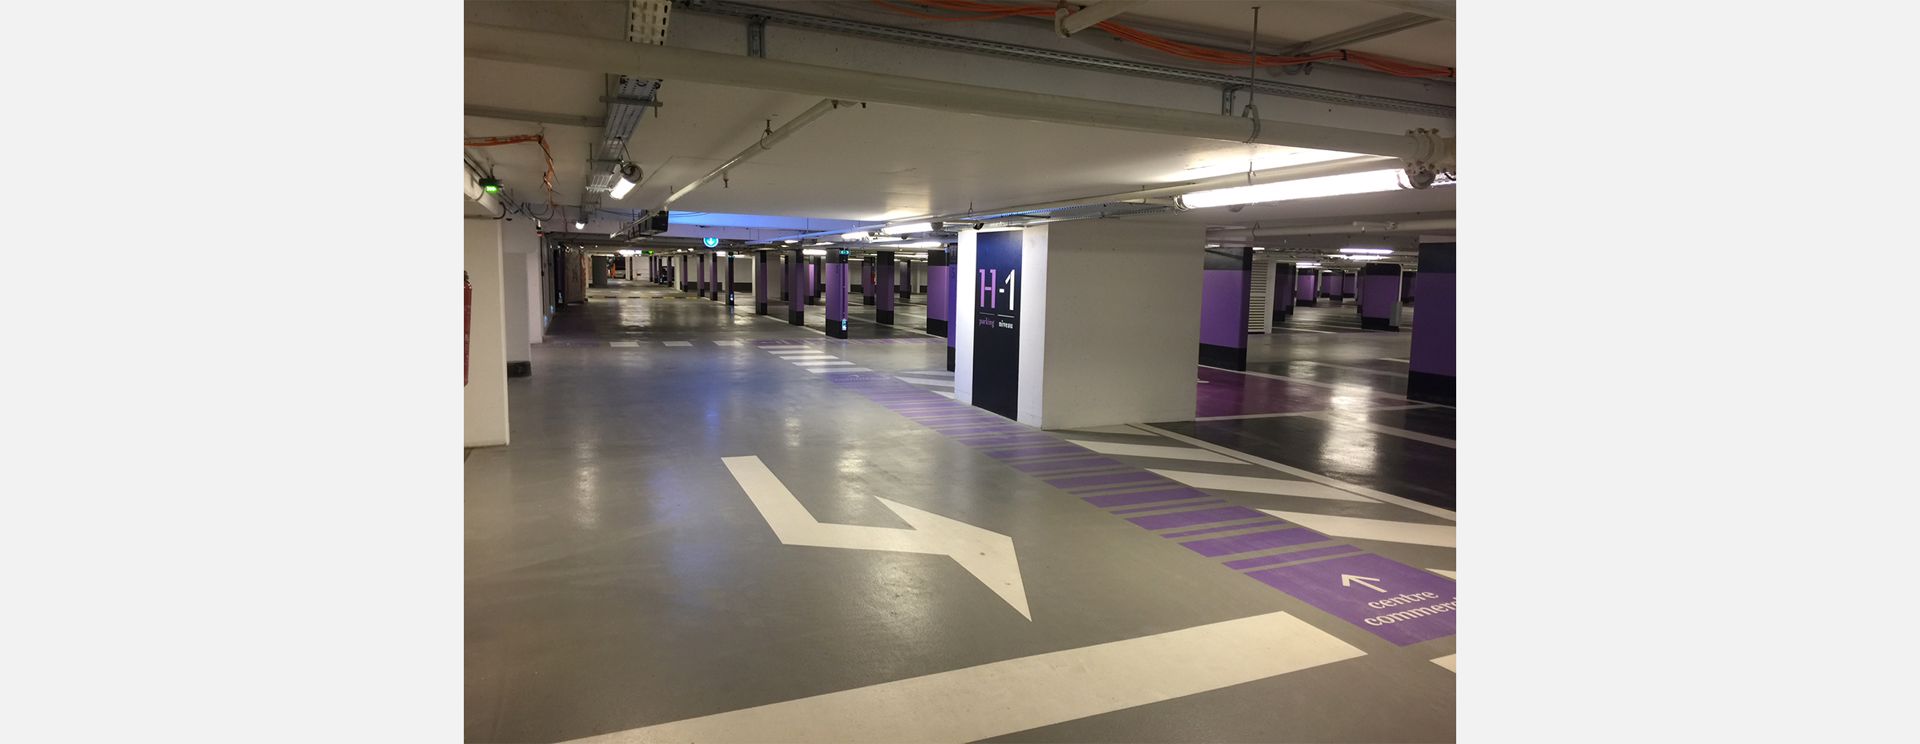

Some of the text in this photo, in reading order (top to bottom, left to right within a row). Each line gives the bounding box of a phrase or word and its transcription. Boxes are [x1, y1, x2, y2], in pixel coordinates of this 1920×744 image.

[979, 268, 1015, 311] H -1
[979, 317, 994, 328] parking
[1368, 591, 1439, 609] centre
